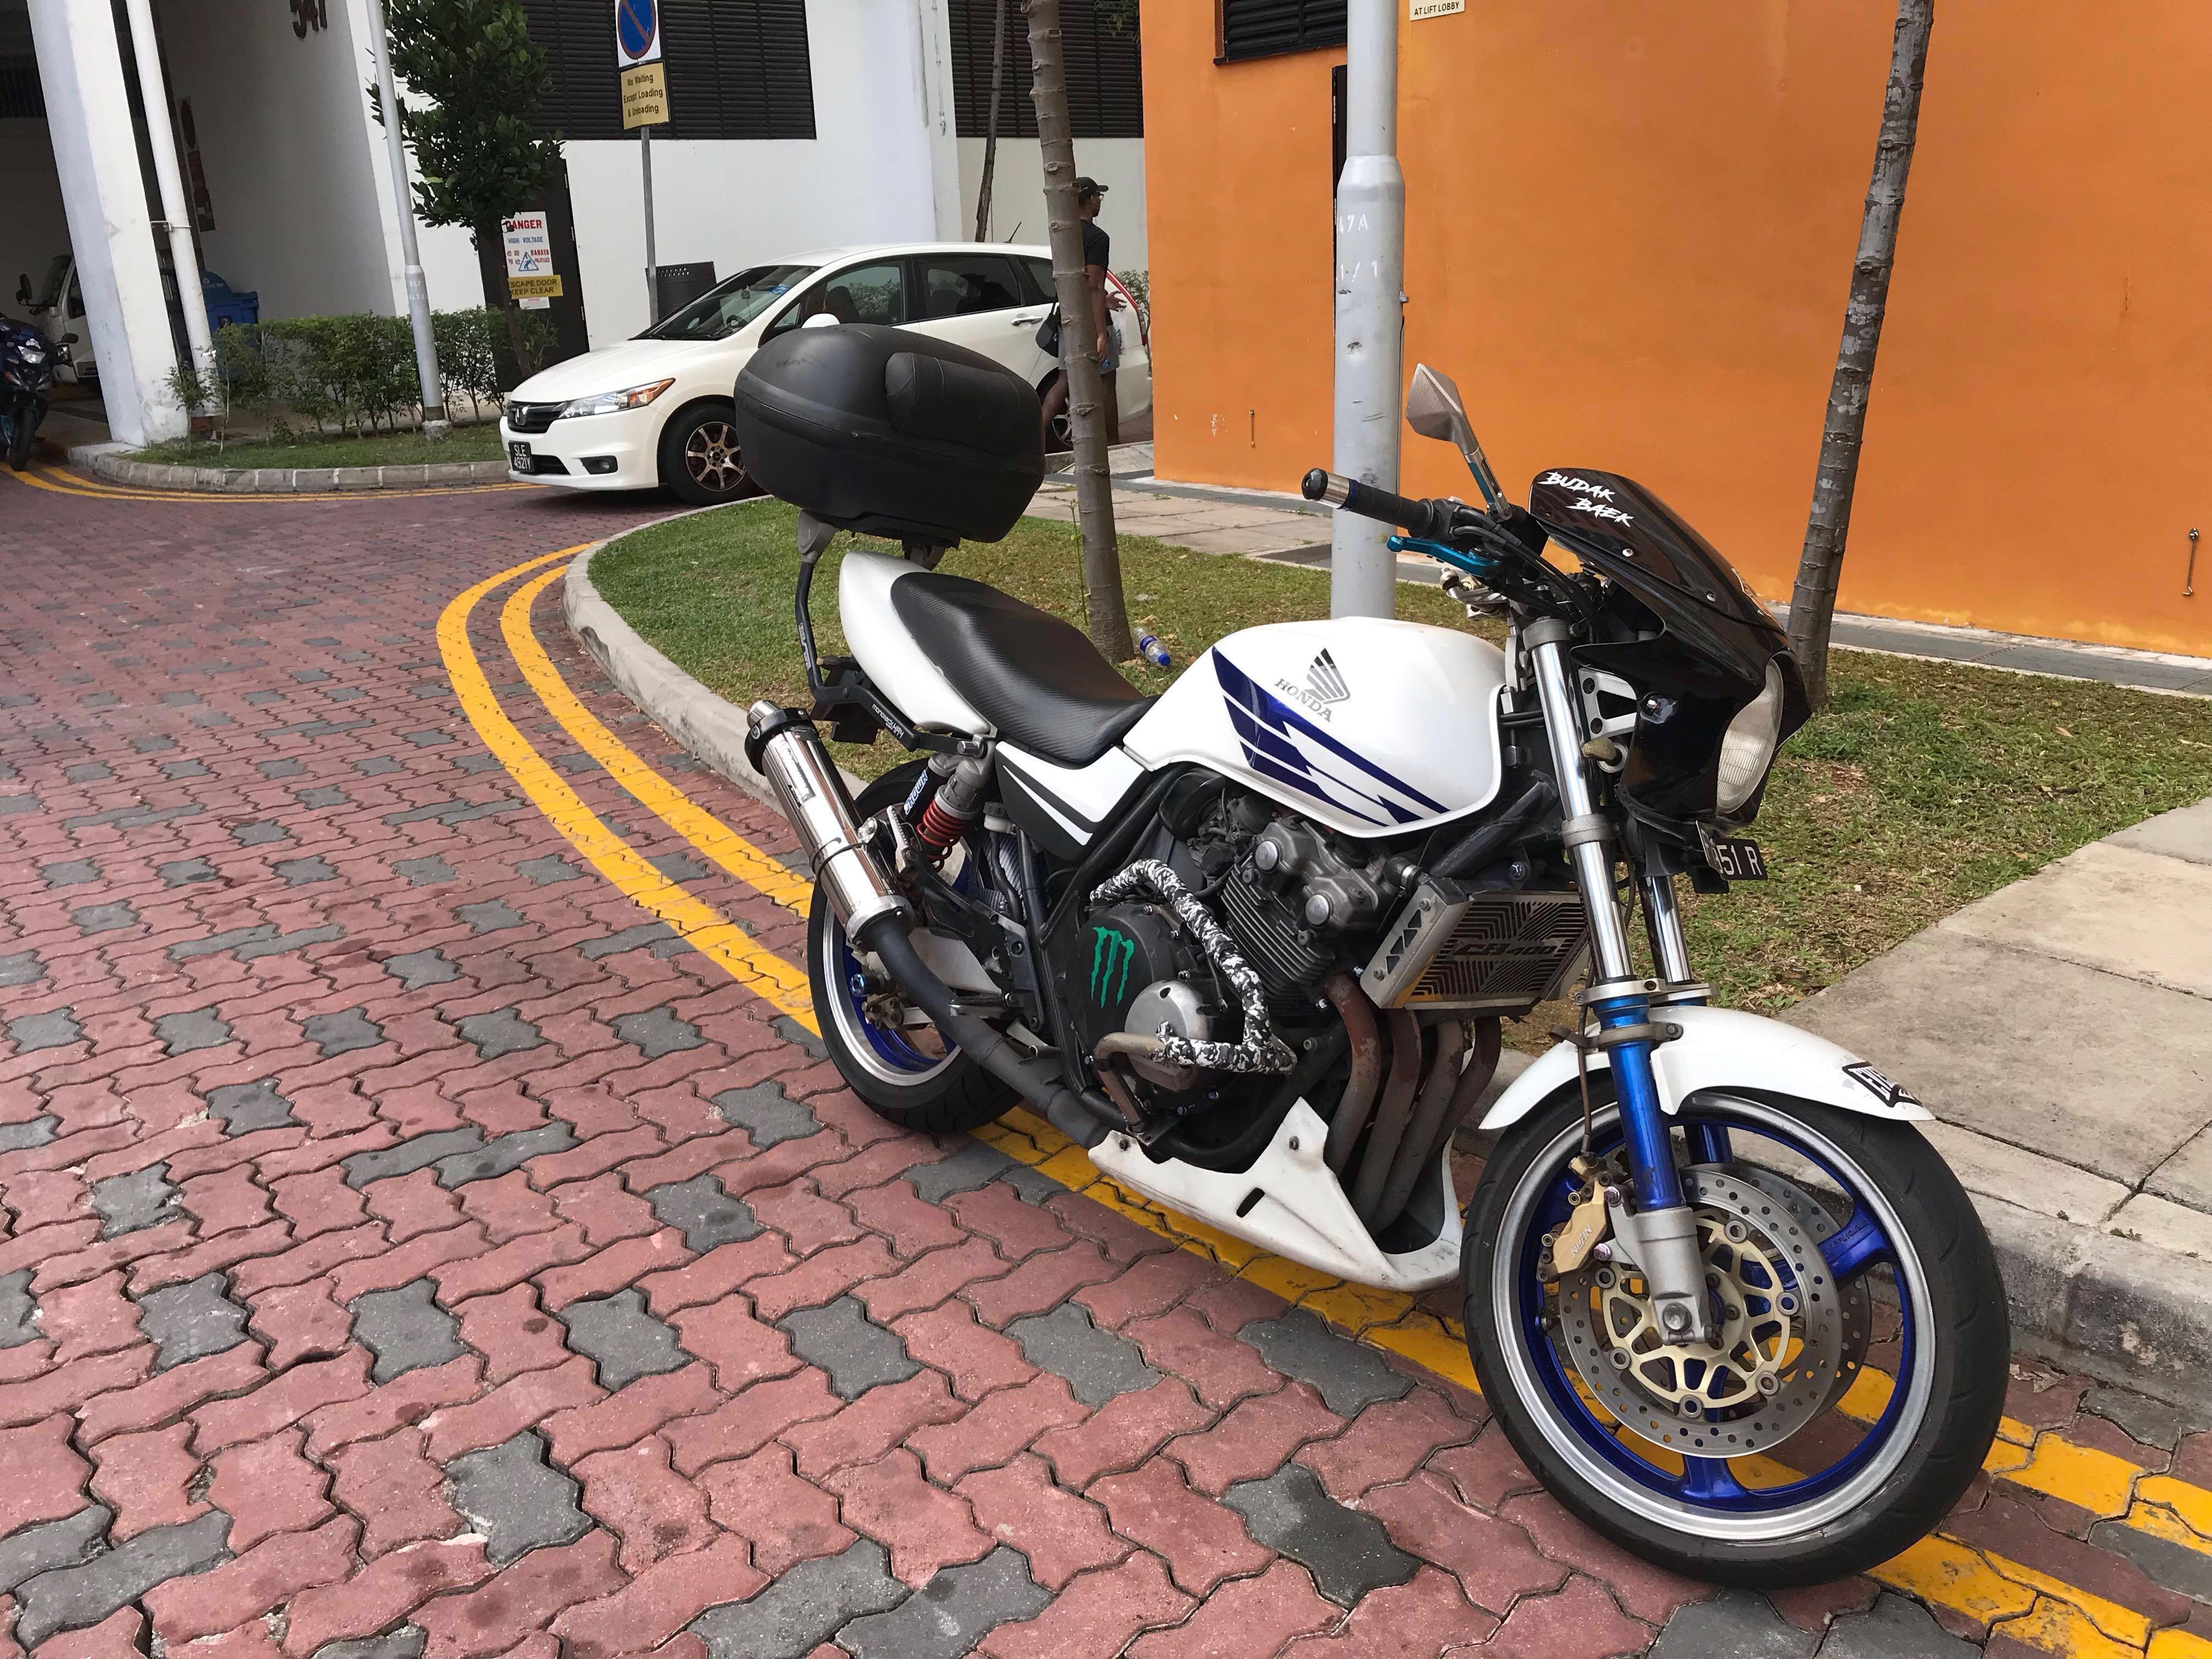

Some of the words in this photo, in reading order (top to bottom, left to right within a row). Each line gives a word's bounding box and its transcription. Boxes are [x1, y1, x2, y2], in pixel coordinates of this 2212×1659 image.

[1414, 8, 1423, 16] AT
[1424, 5, 1437, 14] LIFT
[1438, 1, 1459, 12] LOBBY
[627, 78, 633, 86] No
[635, 74, 653, 83] Waiting
[624, 93, 637, 103] Except
[638, 88, 663, 98] Loading
[628, 109, 631, 117] &
[632, 104, 659, 116] Unloading
[514, 444, 527, 457] SLE
[514, 456, 531, 470] 4921Y
[1538, 471, 1616, 503] BUDAK
[1565, 497, 1634, 528] BAEK
[1274, 678, 1332, 723] HONDA
[904, 770, 928, 815] SHOWA
[1744, 846, 1763, 876] R
